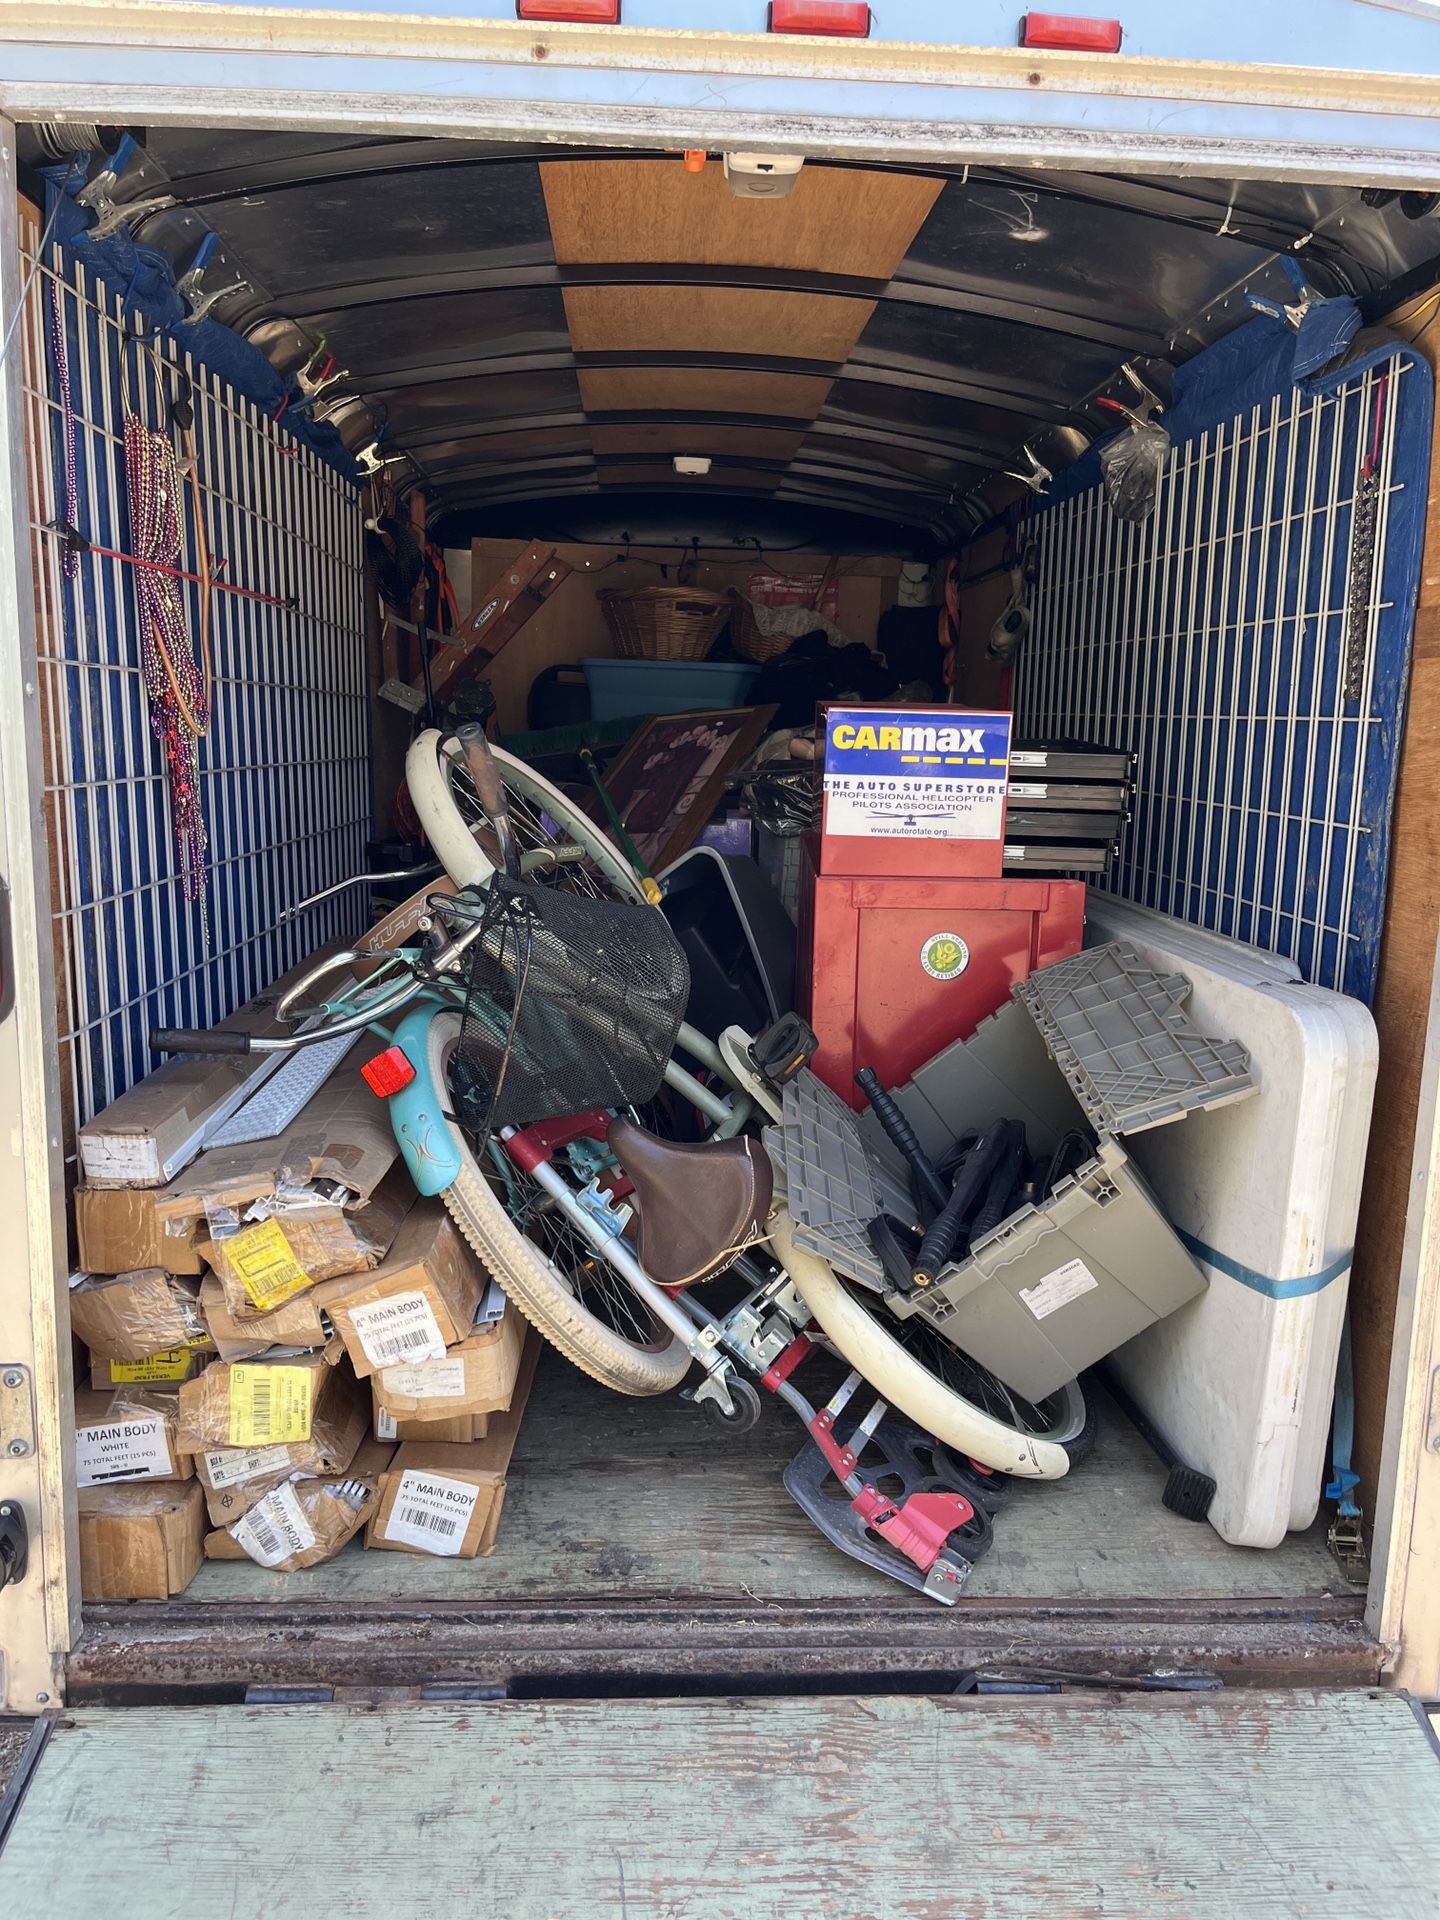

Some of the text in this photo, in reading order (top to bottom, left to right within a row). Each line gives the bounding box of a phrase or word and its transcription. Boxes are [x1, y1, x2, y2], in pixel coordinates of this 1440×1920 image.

[824, 780, 1006, 794] THE AUTO SUPERSTORE
[832, 791, 994, 803] PROFESSIONAL HELICOPTER
[852, 801, 972, 811] PILOTS ASSOCIATION
[870, 826, 948, 837] www.autorotate.org
[369, 895, 431, 951] HUFFY
[368, 1308, 397, 1325] MAIN
[397, 1298, 424, 1315] BODY
[87, 1428, 121, 1442] MAIN
[124, 1423, 157, 1437] BODY
[100, 1442, 129, 1452] WHITE
[93, 1457, 113, 1465] TOTAL
[114, 1454, 129, 1462] FEET
[402, 1480, 415, 1490] 4"
[446, 1491, 475, 1506] BODY
[410, 1495, 428, 1505] TOTAL
[430, 1501, 444, 1510] FEET
[271, 1494, 304, 1550] MAIN BODY
